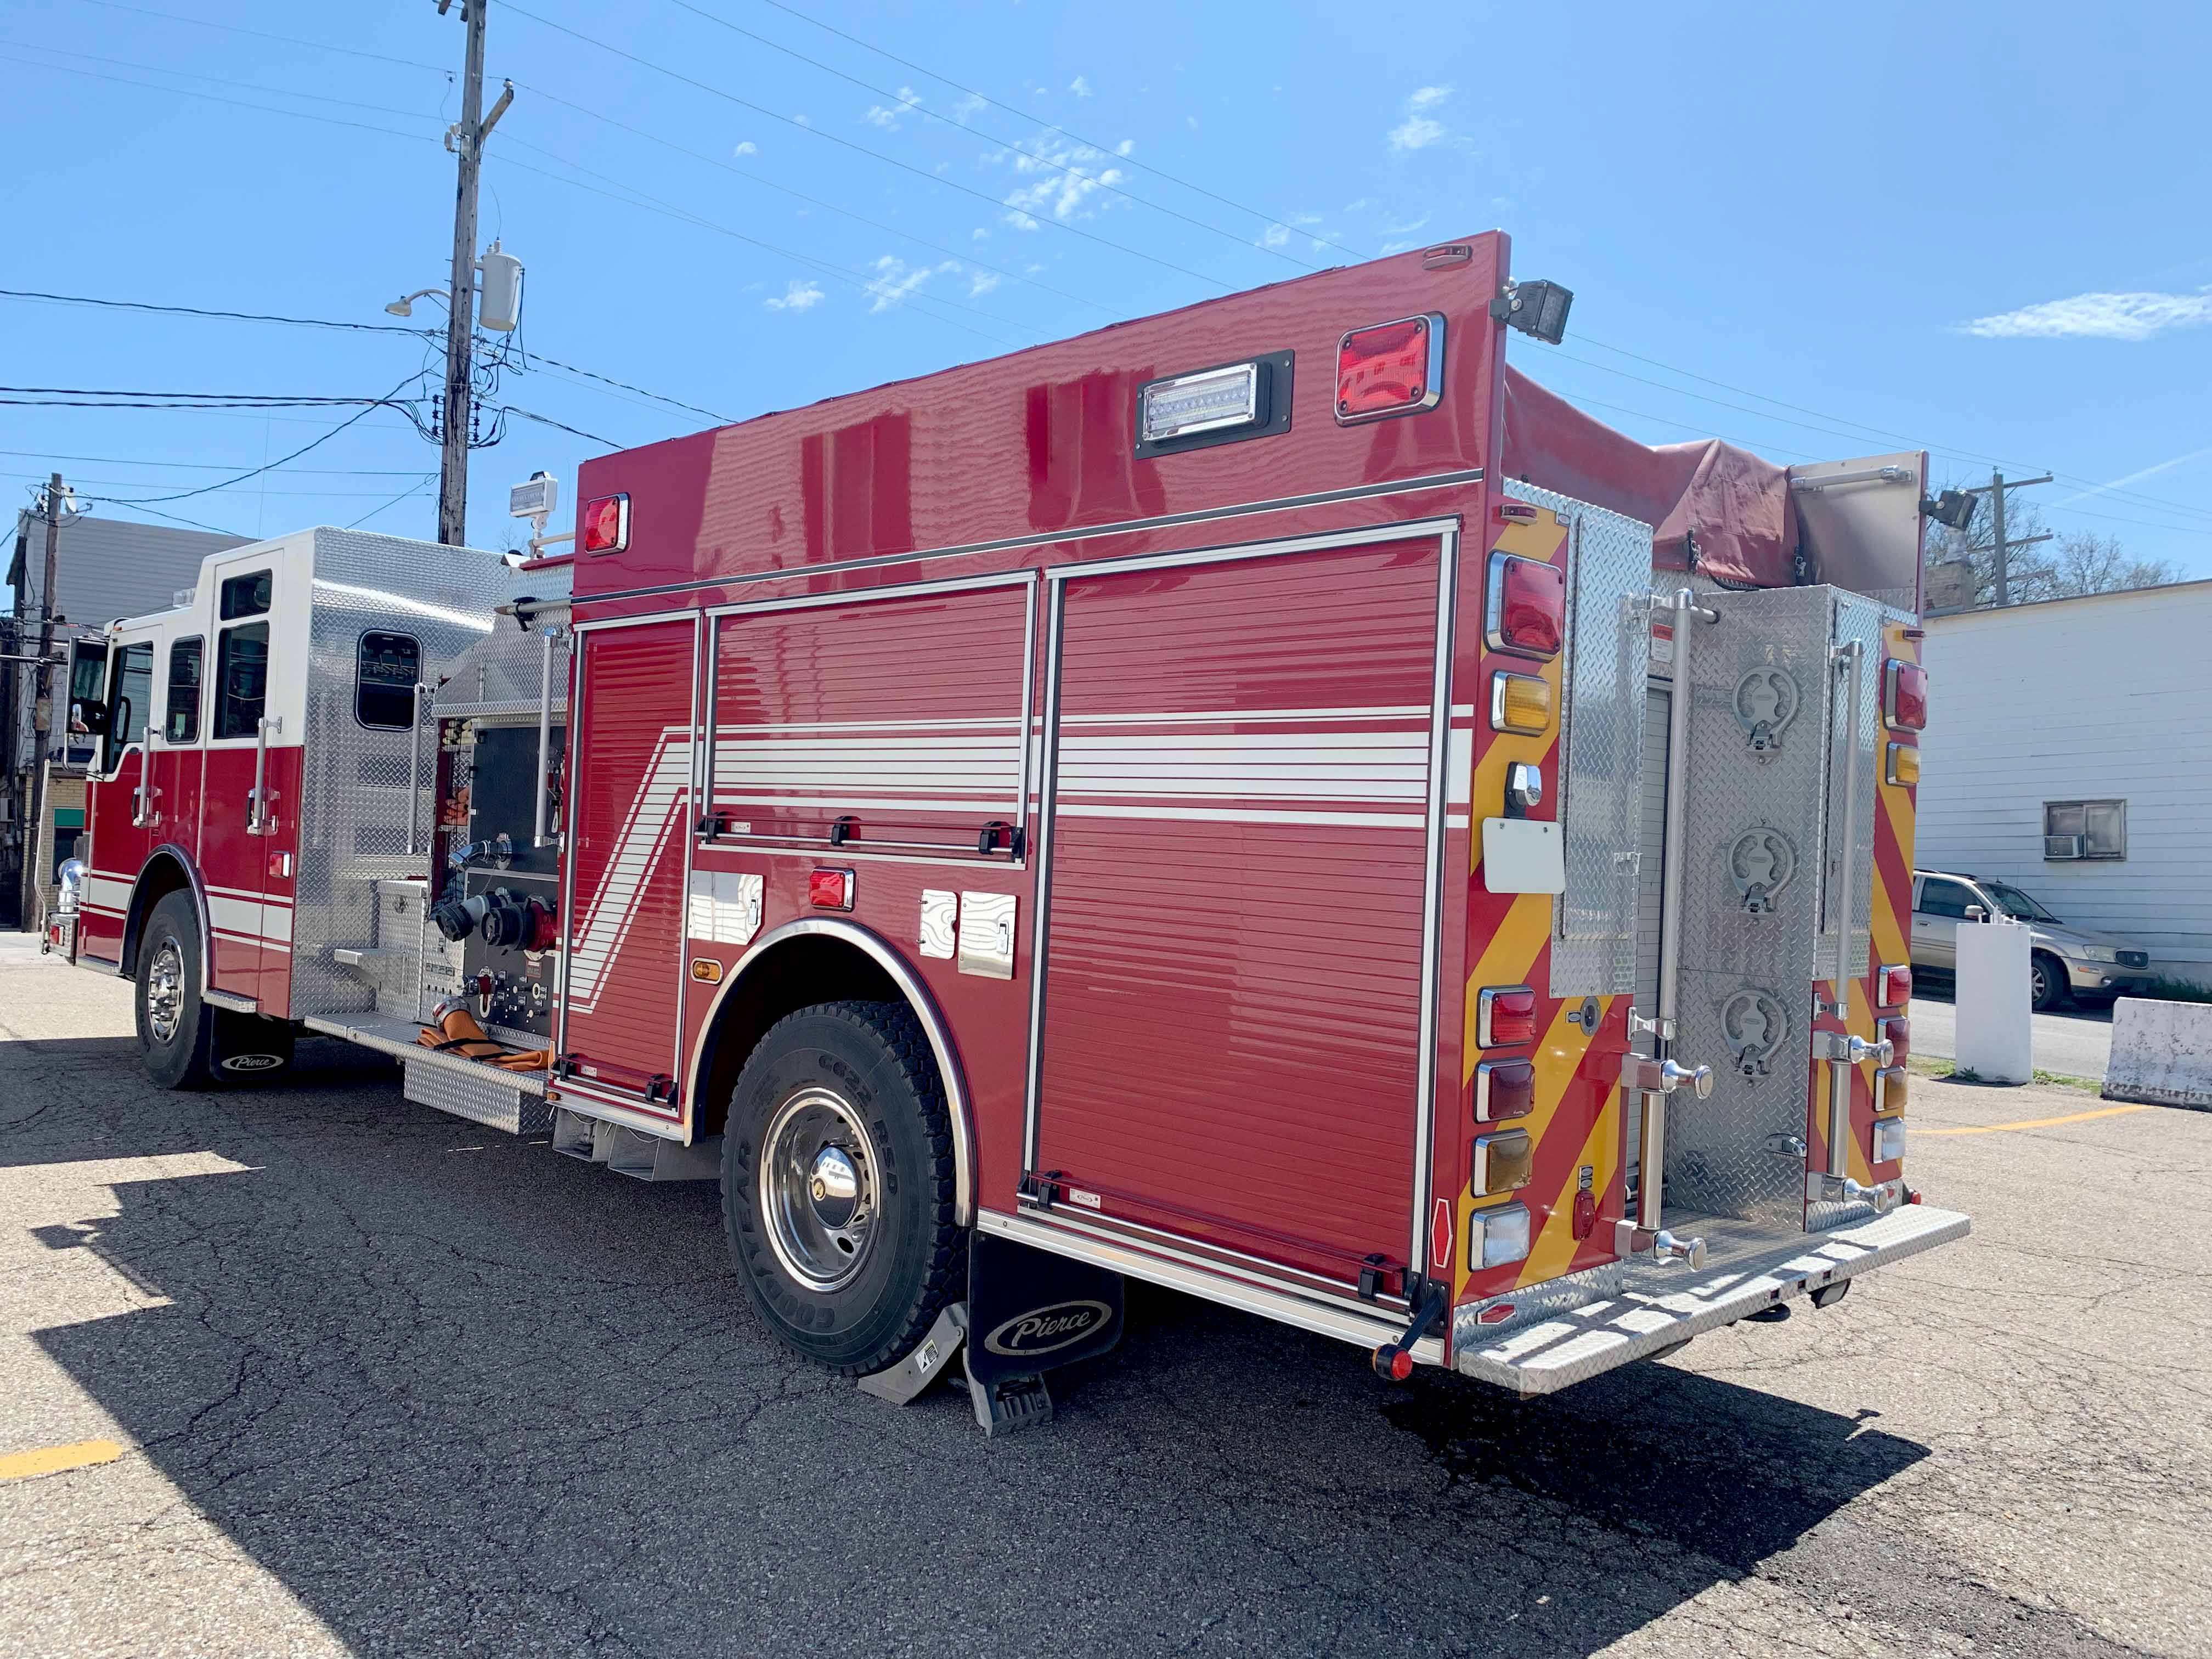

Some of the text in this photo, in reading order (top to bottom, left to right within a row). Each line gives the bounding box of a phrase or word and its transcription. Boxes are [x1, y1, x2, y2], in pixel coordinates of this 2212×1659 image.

[236, 1057, 270, 1068] Pierce
[737, 1140, 835, 1328] GOODYEAR
[1012, 1312, 1091, 1347] Pierce
